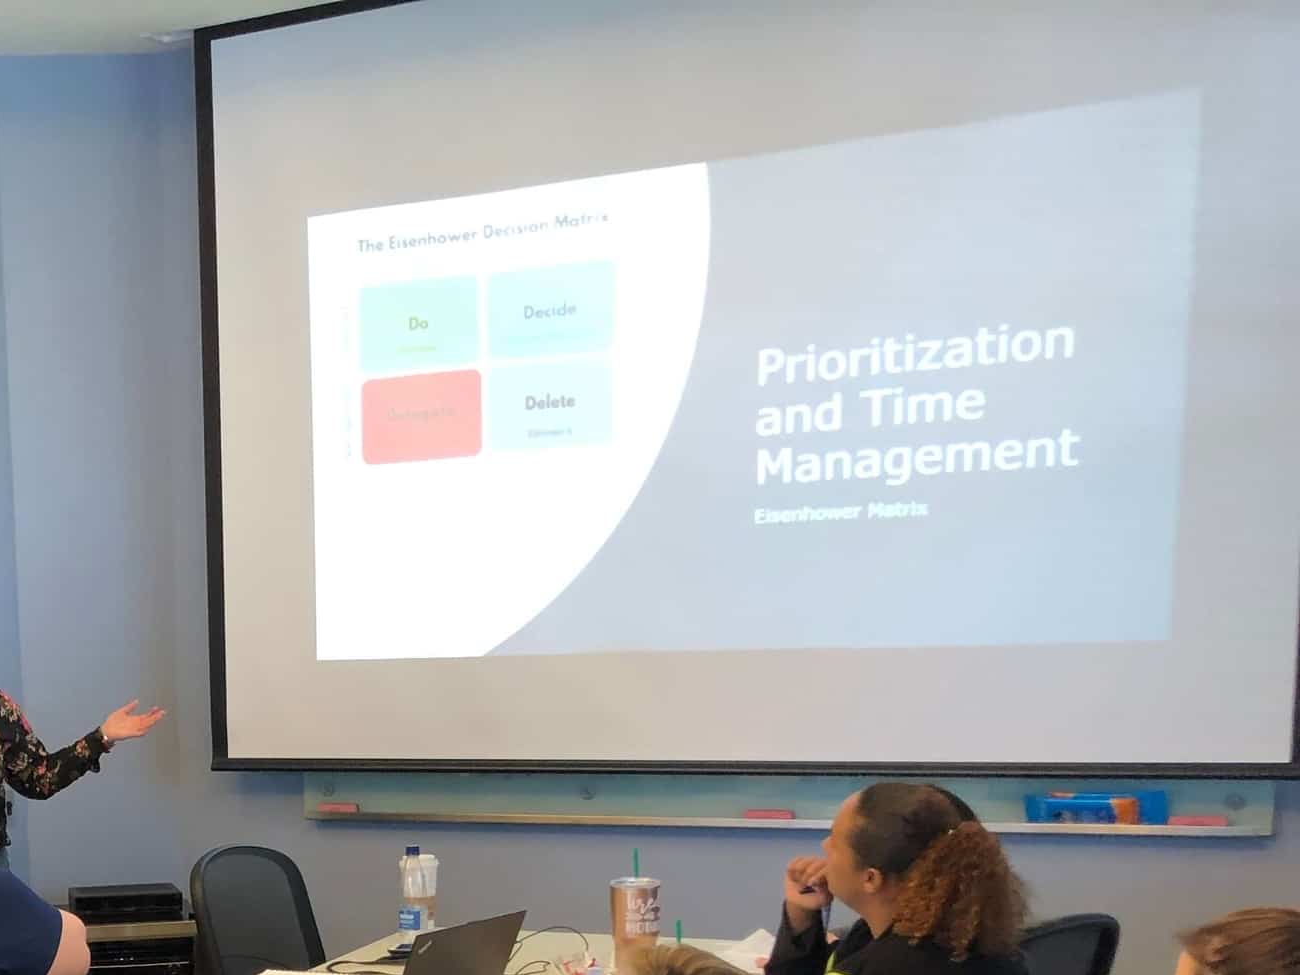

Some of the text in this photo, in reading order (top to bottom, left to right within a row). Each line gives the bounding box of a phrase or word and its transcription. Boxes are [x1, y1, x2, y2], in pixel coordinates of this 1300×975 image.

[356, 211, 610, 254] The Eisenhower Decision Matrix
[408, 316, 429, 331] Do
[523, 300, 577, 320] Decide
[757, 323, 1075, 387] Prioritization
[525, 393, 576, 412] Delete
[755, 387, 986, 437] and Time
[756, 428, 1082, 487] Management
[754, 501, 929, 526] Eisenhower Matrix
